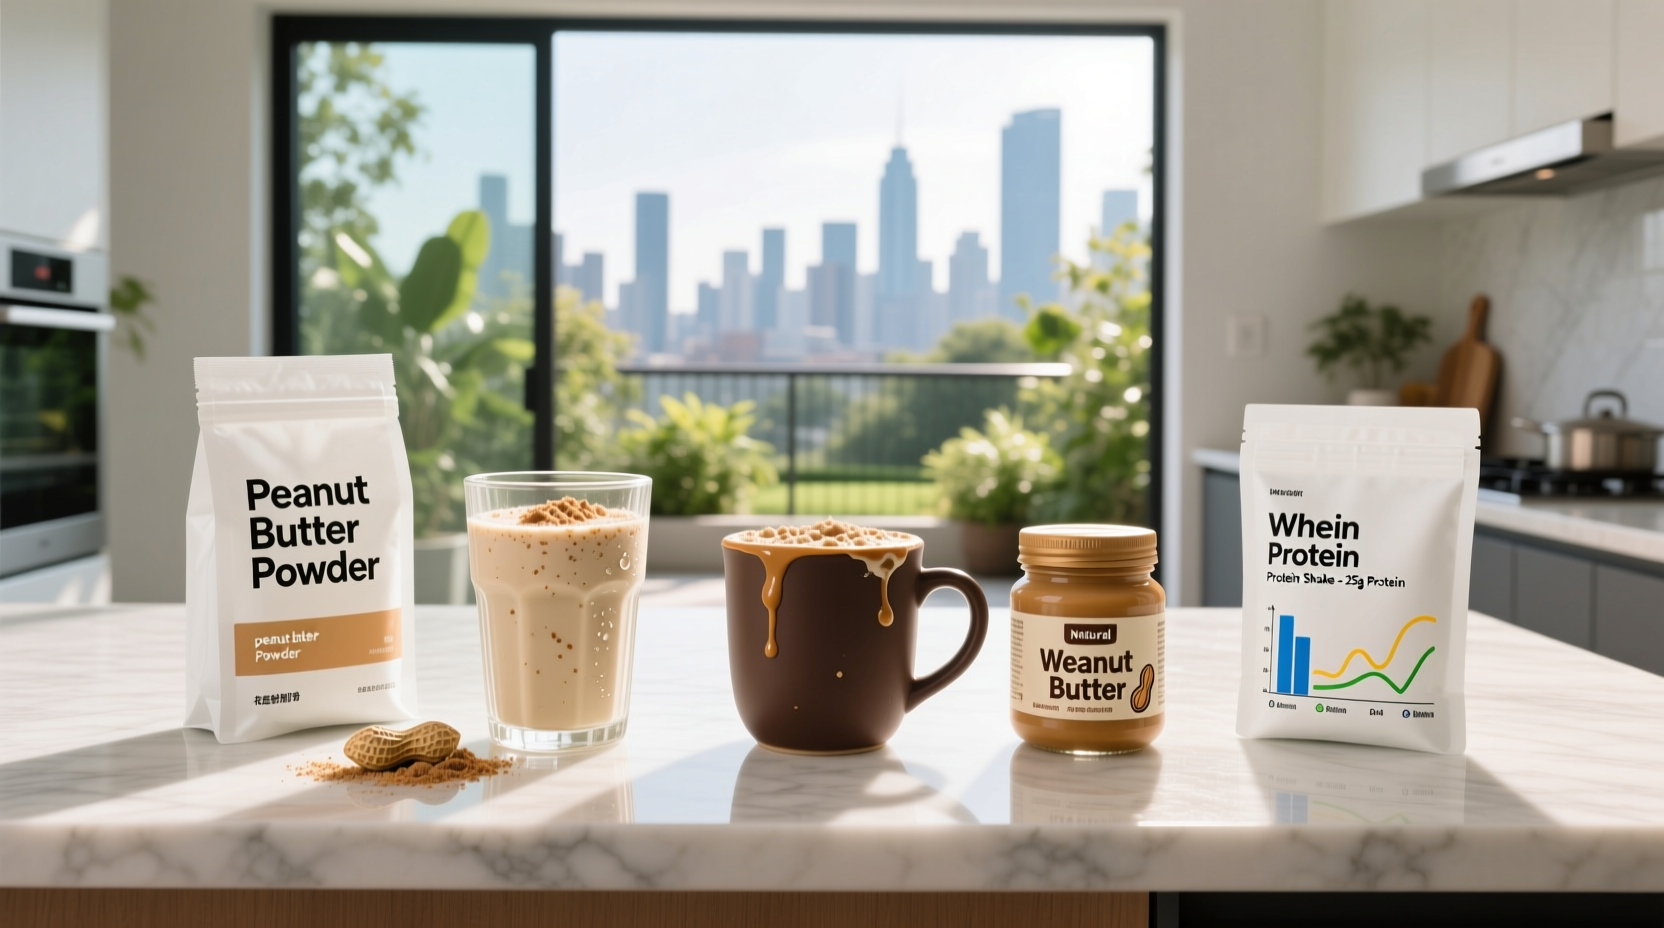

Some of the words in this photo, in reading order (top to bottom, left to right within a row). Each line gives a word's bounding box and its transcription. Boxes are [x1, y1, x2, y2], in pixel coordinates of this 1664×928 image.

[246, 476, 370, 511] Peanut
[249, 515, 359, 550] Butter
[1268, 512, 1360, 540] Whein
[1268, 542, 1360, 568] Protein
[252, 550, 380, 589] Powder
[1345, 575, 1364, 590] 25g
[1367, 576, 1406, 588] Protein
[1040, 648, 1133, 674] Weanut
[1049, 676, 1126, 701] Butter
